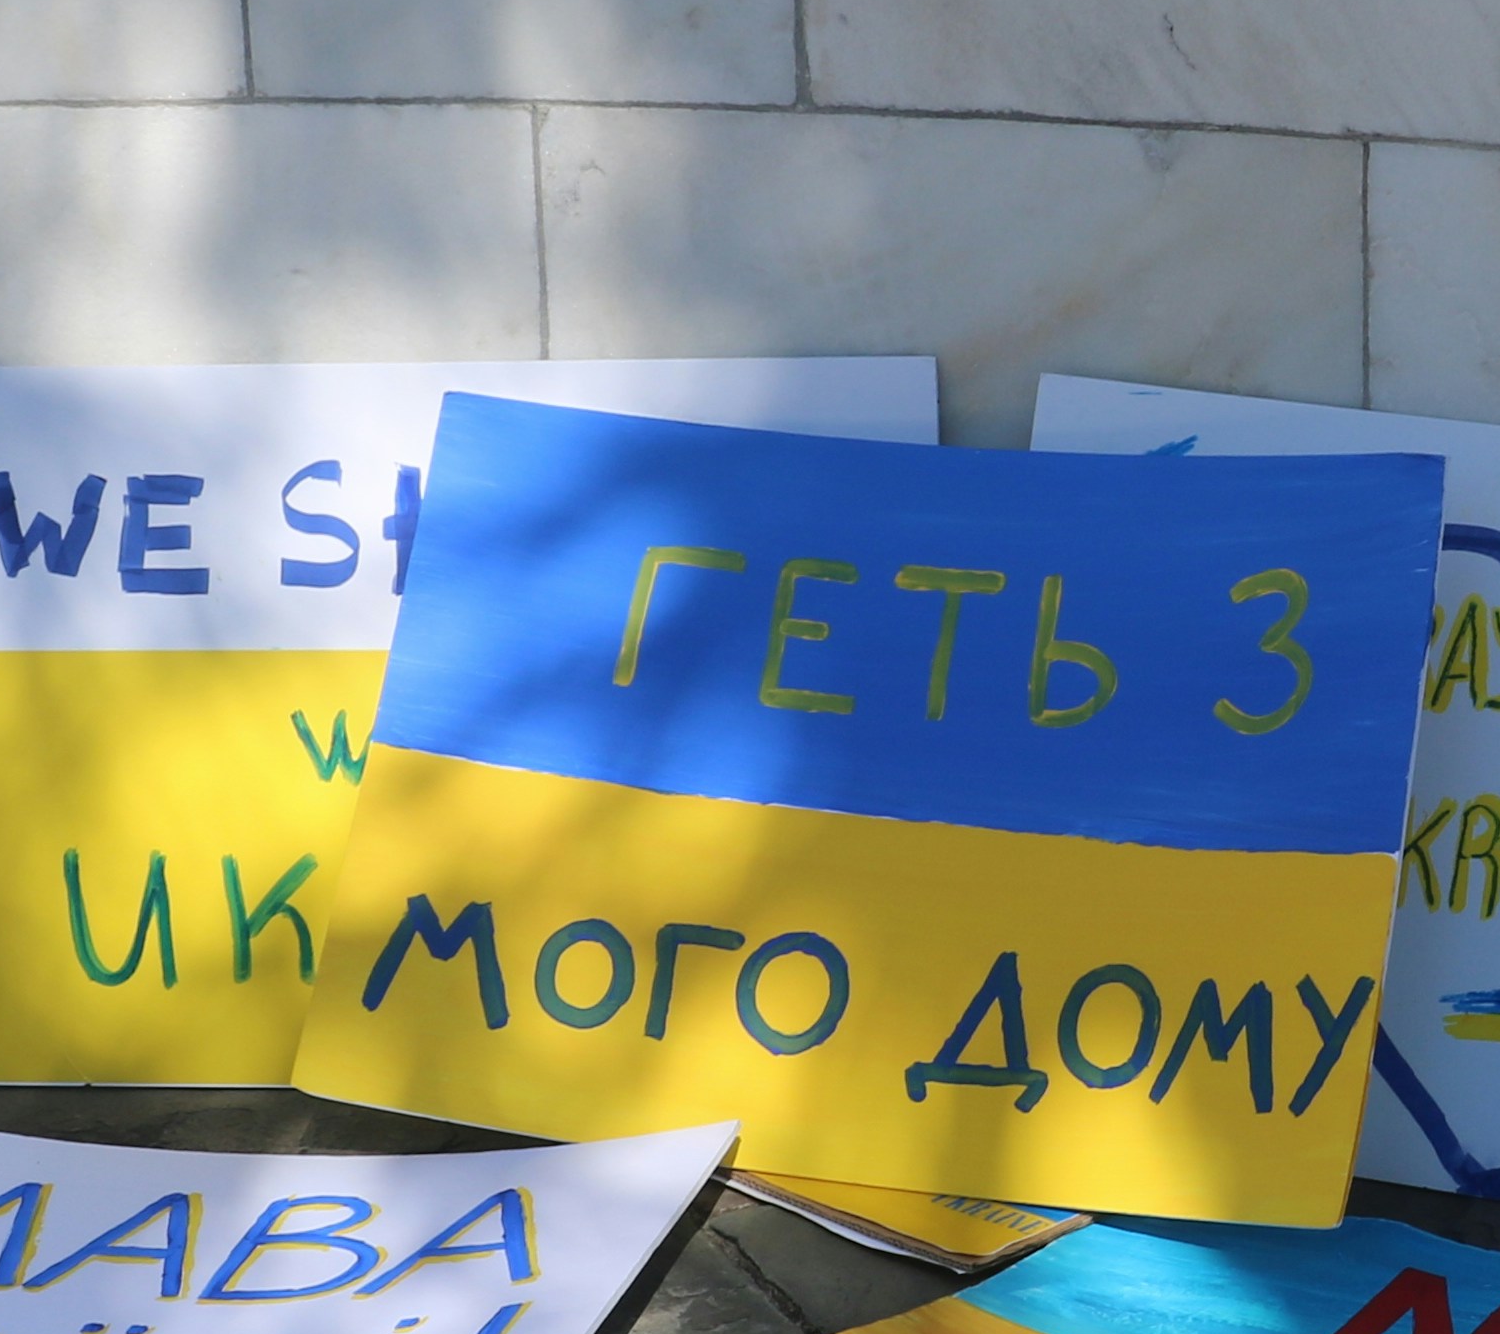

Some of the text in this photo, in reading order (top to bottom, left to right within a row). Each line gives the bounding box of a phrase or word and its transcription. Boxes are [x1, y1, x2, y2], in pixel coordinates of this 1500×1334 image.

[612, 543, 1120, 729] ГЕТЬ
[62, 847, 318, 989] UK
[361, 893, 1377, 1118] МОГО ДОМУ
